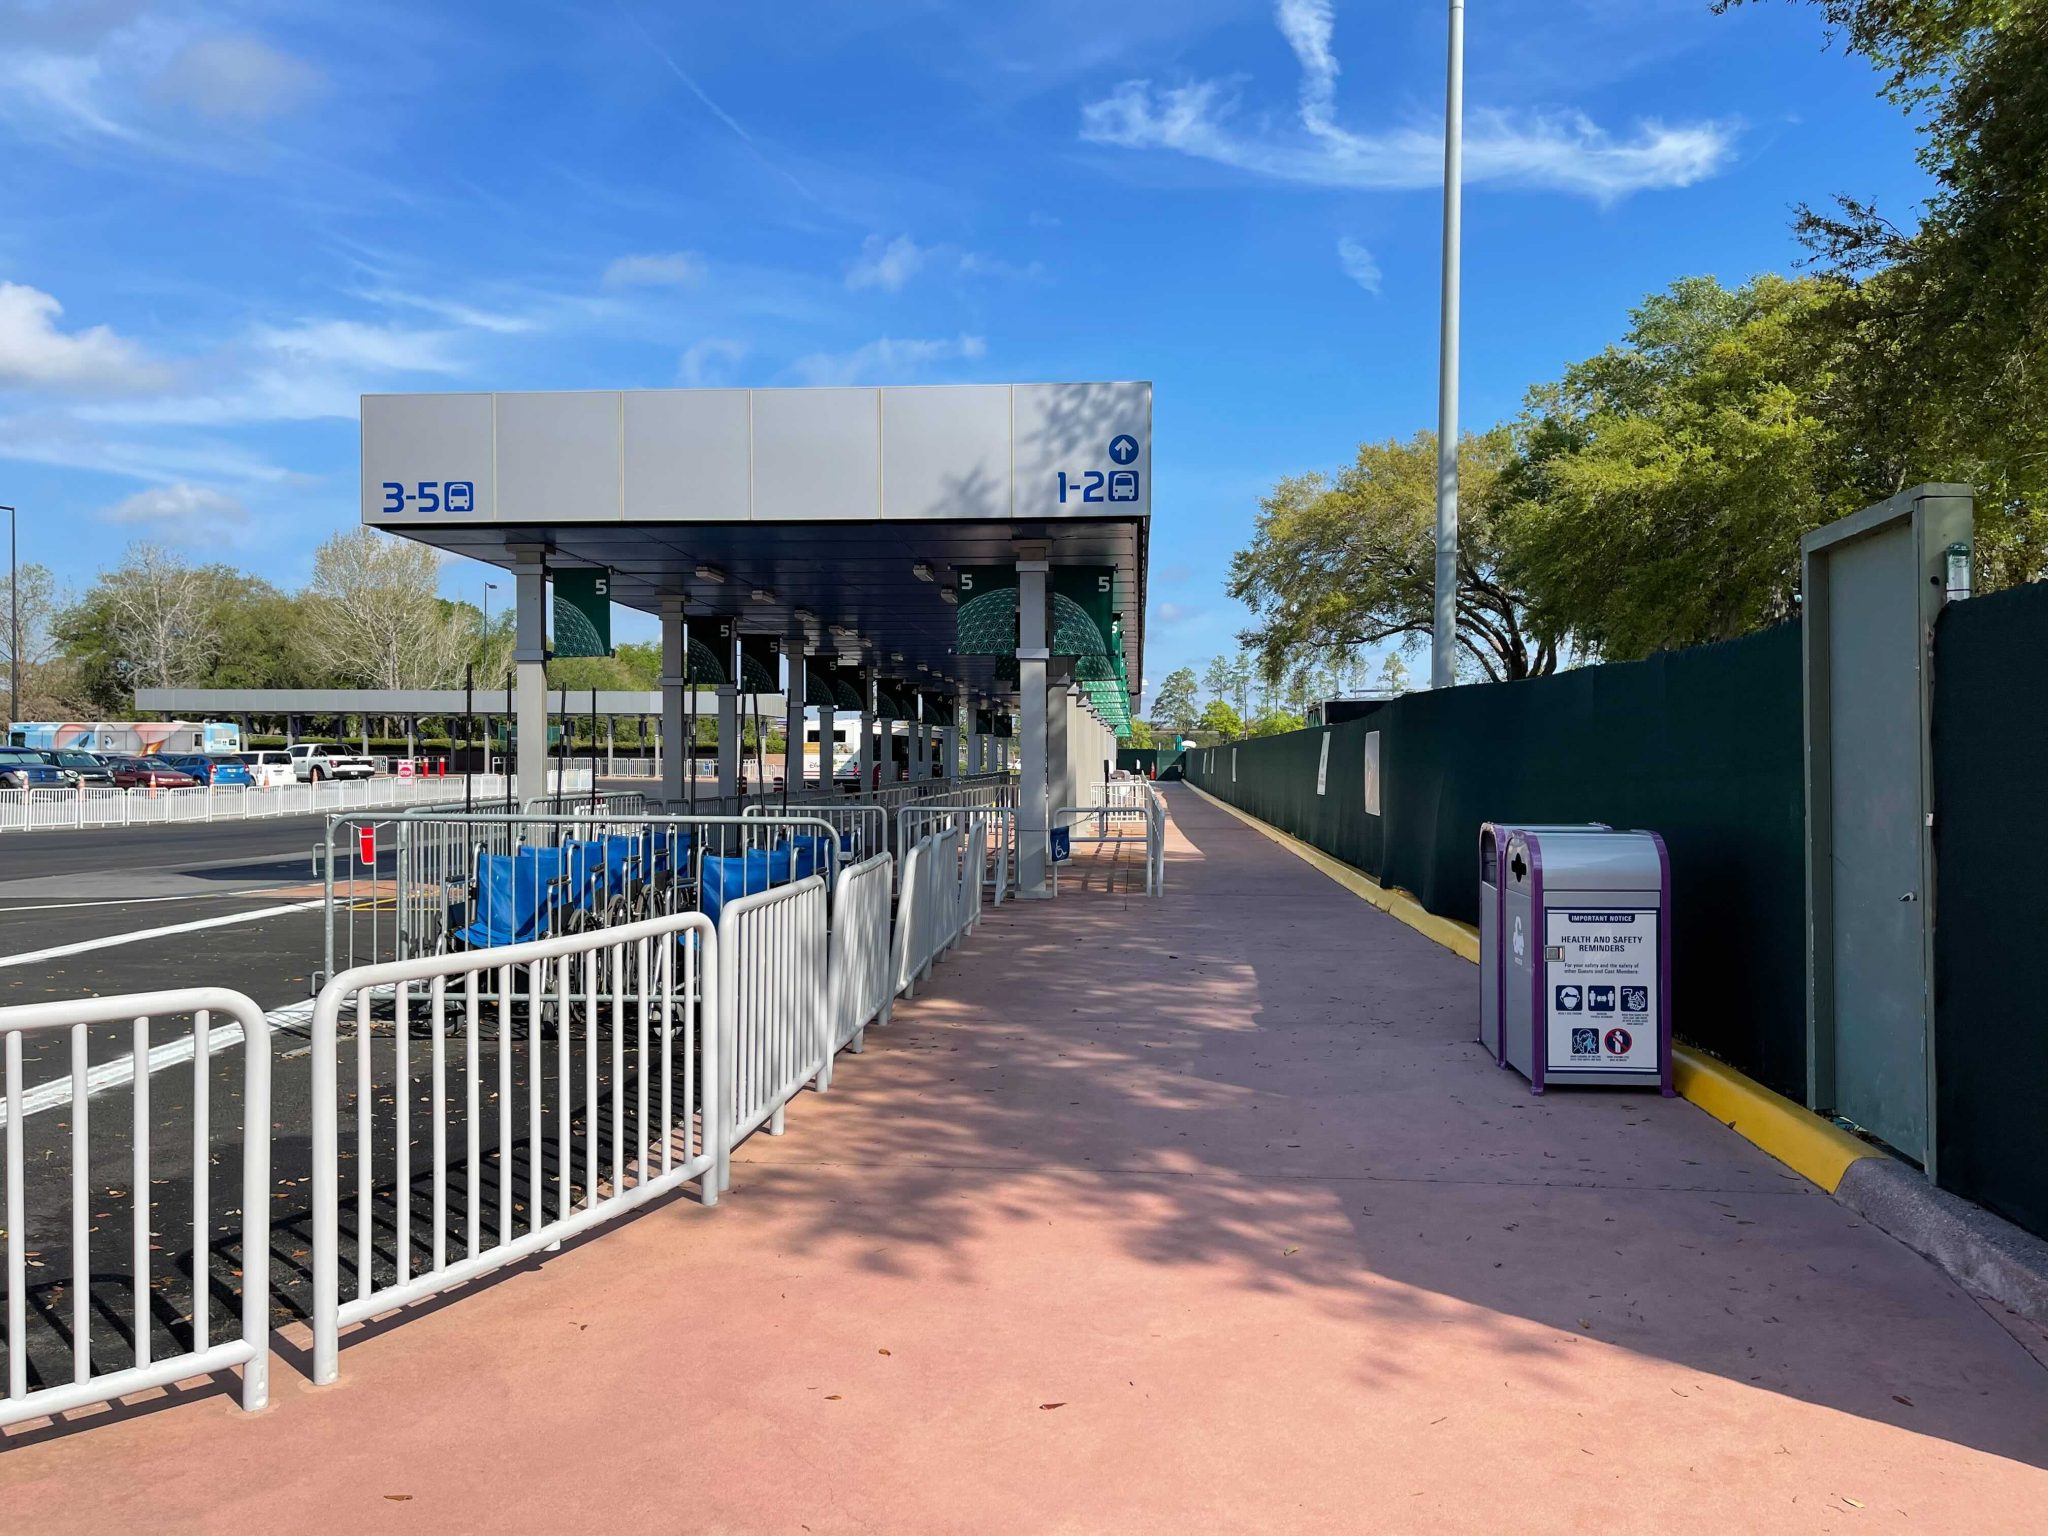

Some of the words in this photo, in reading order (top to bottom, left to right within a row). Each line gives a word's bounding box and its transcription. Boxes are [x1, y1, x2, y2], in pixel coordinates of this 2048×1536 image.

[1058, 471, 1104, 503] 1-2
[383, 482, 439, 512] 3-5
[595, 579, 607, 595] 5
[961, 574, 973, 590] 5
[1098, 576, 1110, 592] 5
[720, 625, 729, 637] 5
[770, 642, 778, 653] 5
[829, 661, 837, 671] 5
[859, 671, 866, 680] 5
[1561, 935, 1591, 943] HEALTH
[1612, 936, 1643, 944] SAFETY
[1578, 944, 1625, 952] REMINDERS
